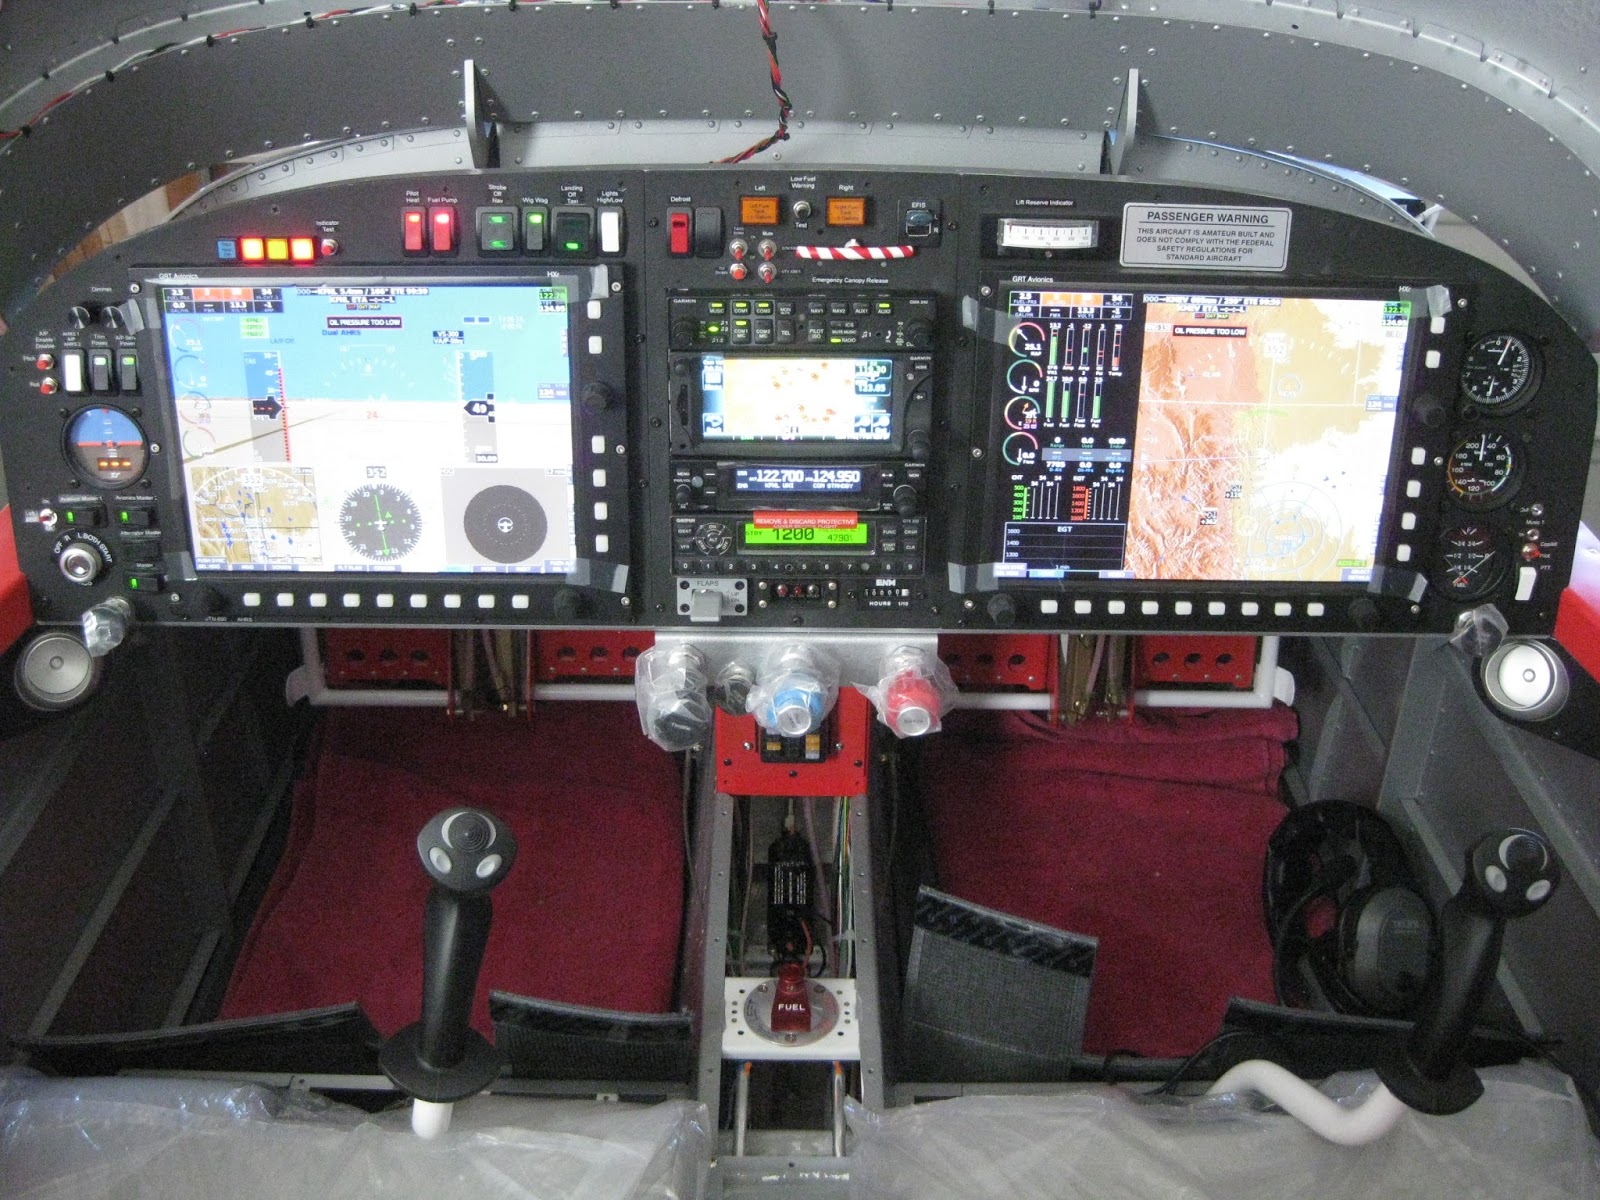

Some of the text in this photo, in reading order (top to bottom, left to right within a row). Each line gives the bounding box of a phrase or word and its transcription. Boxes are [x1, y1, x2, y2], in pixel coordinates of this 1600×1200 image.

[791, 182, 815, 190] Warning
[1147, 211, 1268, 223] PASSENGER WARNING
[811, 276, 843, 284] Emergency
[844, 277, 865, 285] Canopy
[83, 533, 100, 545] BOTH
[99, 543, 113, 563] START
